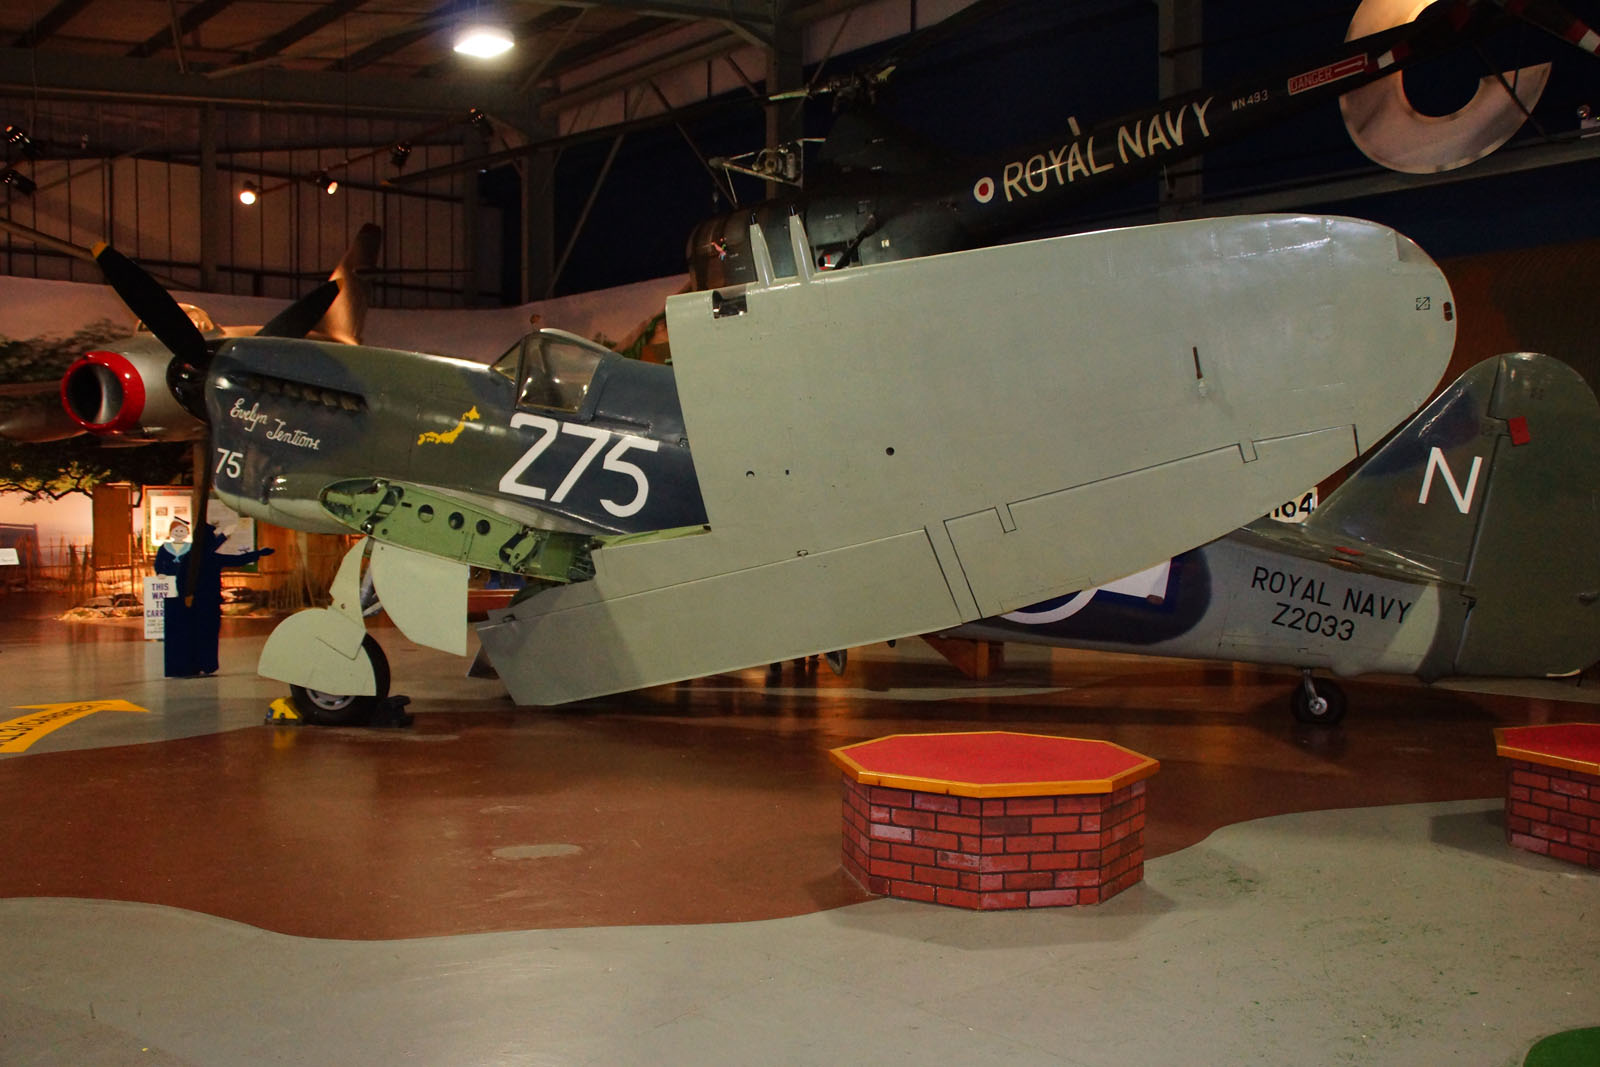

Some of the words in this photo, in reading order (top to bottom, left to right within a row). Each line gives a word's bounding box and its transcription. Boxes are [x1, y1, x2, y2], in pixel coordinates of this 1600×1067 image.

[1291, 67, 1332, 91] DANGER
[1003, 136, 1115, 202] ROYAL
[1117, 96, 1215, 164] NAVY
[230, 397, 268, 432] Evelyn
[216, 447, 244, 478] 75
[499, 412, 660, 518] 275
[1418, 446, 1483, 514] N
[152, 583, 169, 591] THIS
[1251, 566, 1331, 607] ROYAL
[1343, 588, 1412, 624] NAVY
[1271, 602, 1355, 641] Z2033
